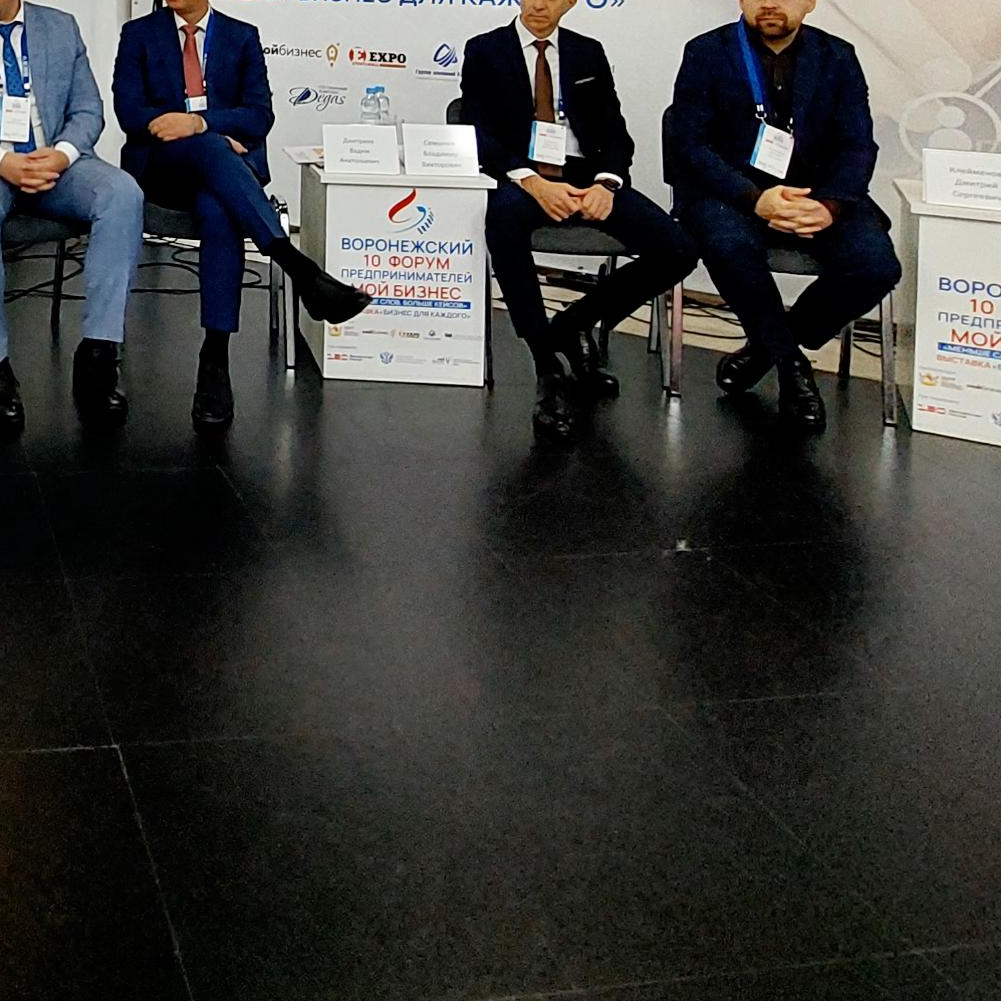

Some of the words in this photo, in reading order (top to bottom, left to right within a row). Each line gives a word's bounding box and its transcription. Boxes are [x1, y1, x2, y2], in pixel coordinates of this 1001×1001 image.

[263, 43, 323, 59] ойбизнес
[369, 50, 407, 64] EXPO
[340, 237, 474, 256] ВОРОНЕЖСКИЙ
[363, 254, 381, 268] 10
[388, 255, 450, 270] ФОРУМ
[340, 268, 473, 284] ПРЕДПРИНИМАТЕЛЕЙ
[393, 284, 462, 300] БИЗНЕС
[969, 298, 994, 315] 10
